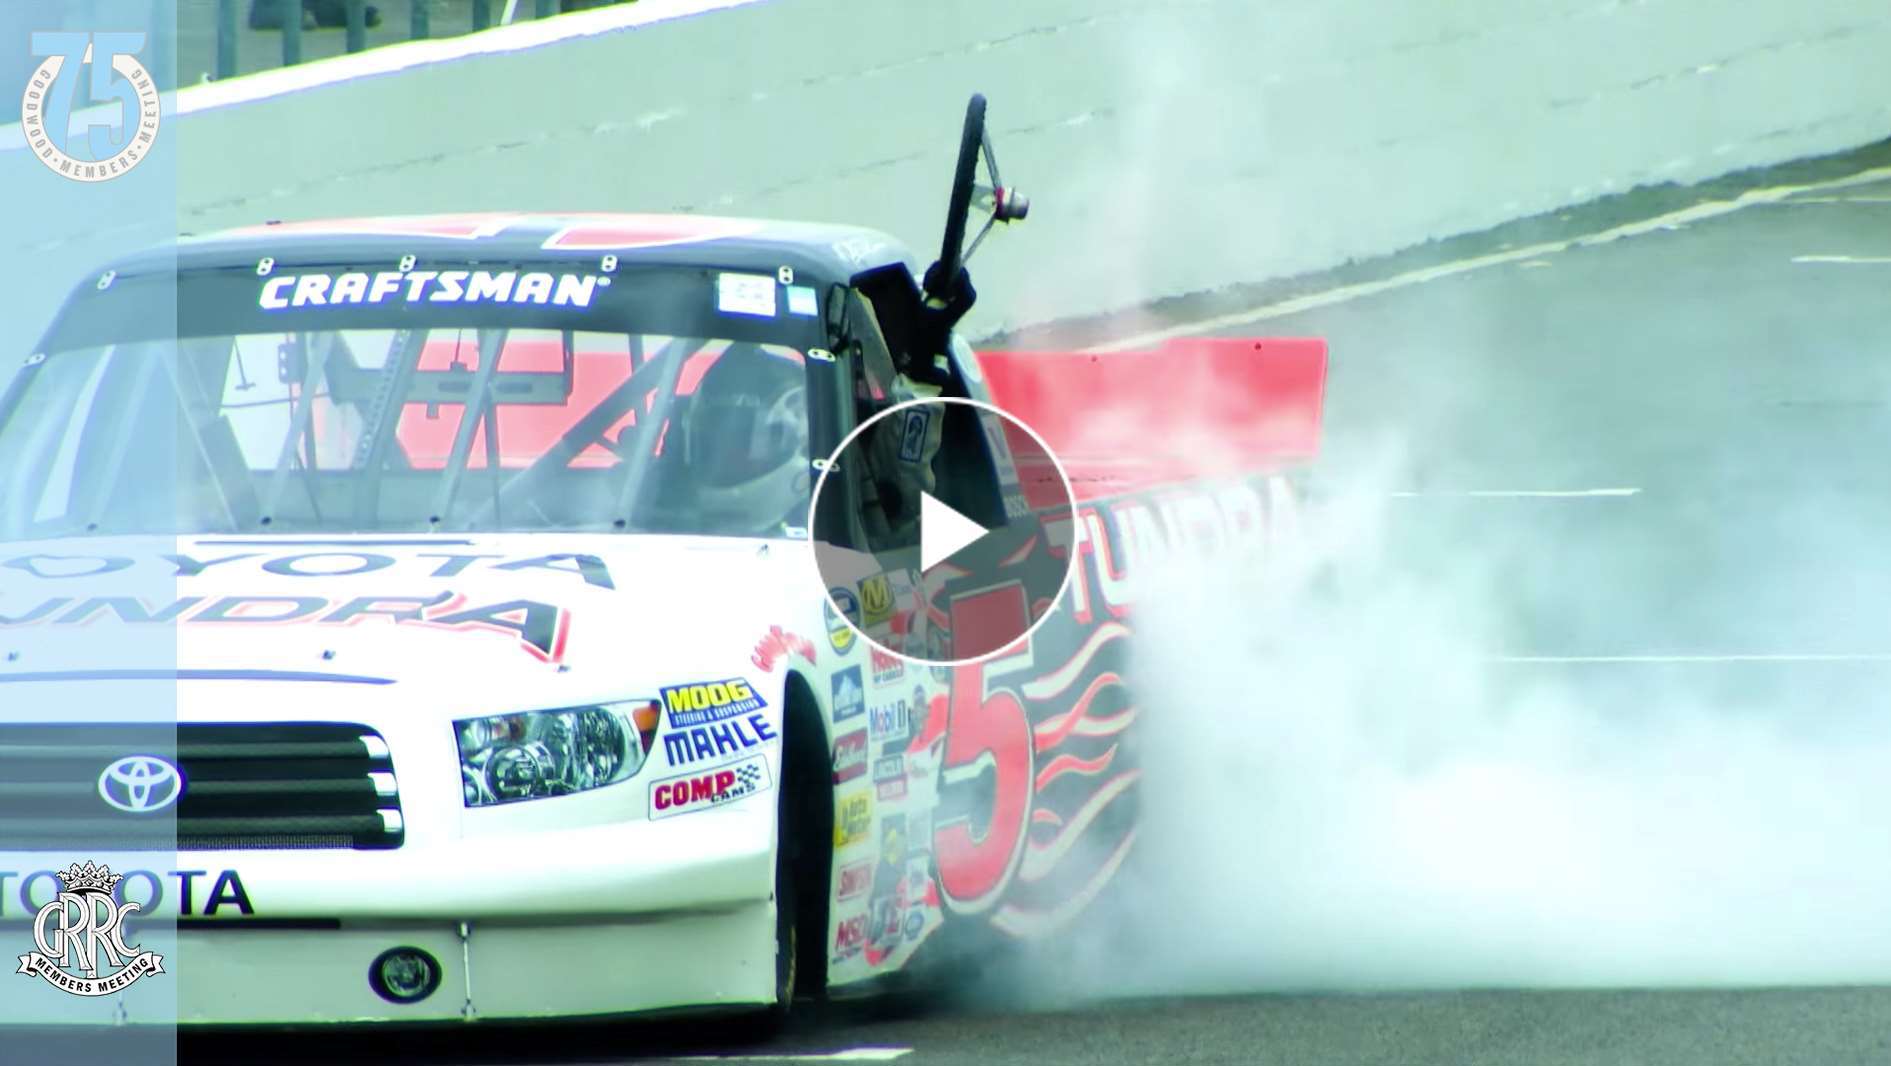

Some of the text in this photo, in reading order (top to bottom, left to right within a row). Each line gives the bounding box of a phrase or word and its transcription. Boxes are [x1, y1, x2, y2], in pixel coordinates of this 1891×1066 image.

[258, 271, 600, 309] CRAFTSMAN
[666, 682, 752, 714] MOOG
[663, 713, 778, 768] MAHLE
[933, 579, 1034, 915] 5
[655, 769, 735, 810] COMP
[711, 782, 757, 803] CAMS
[0, 869, 254, 918] OOTA
